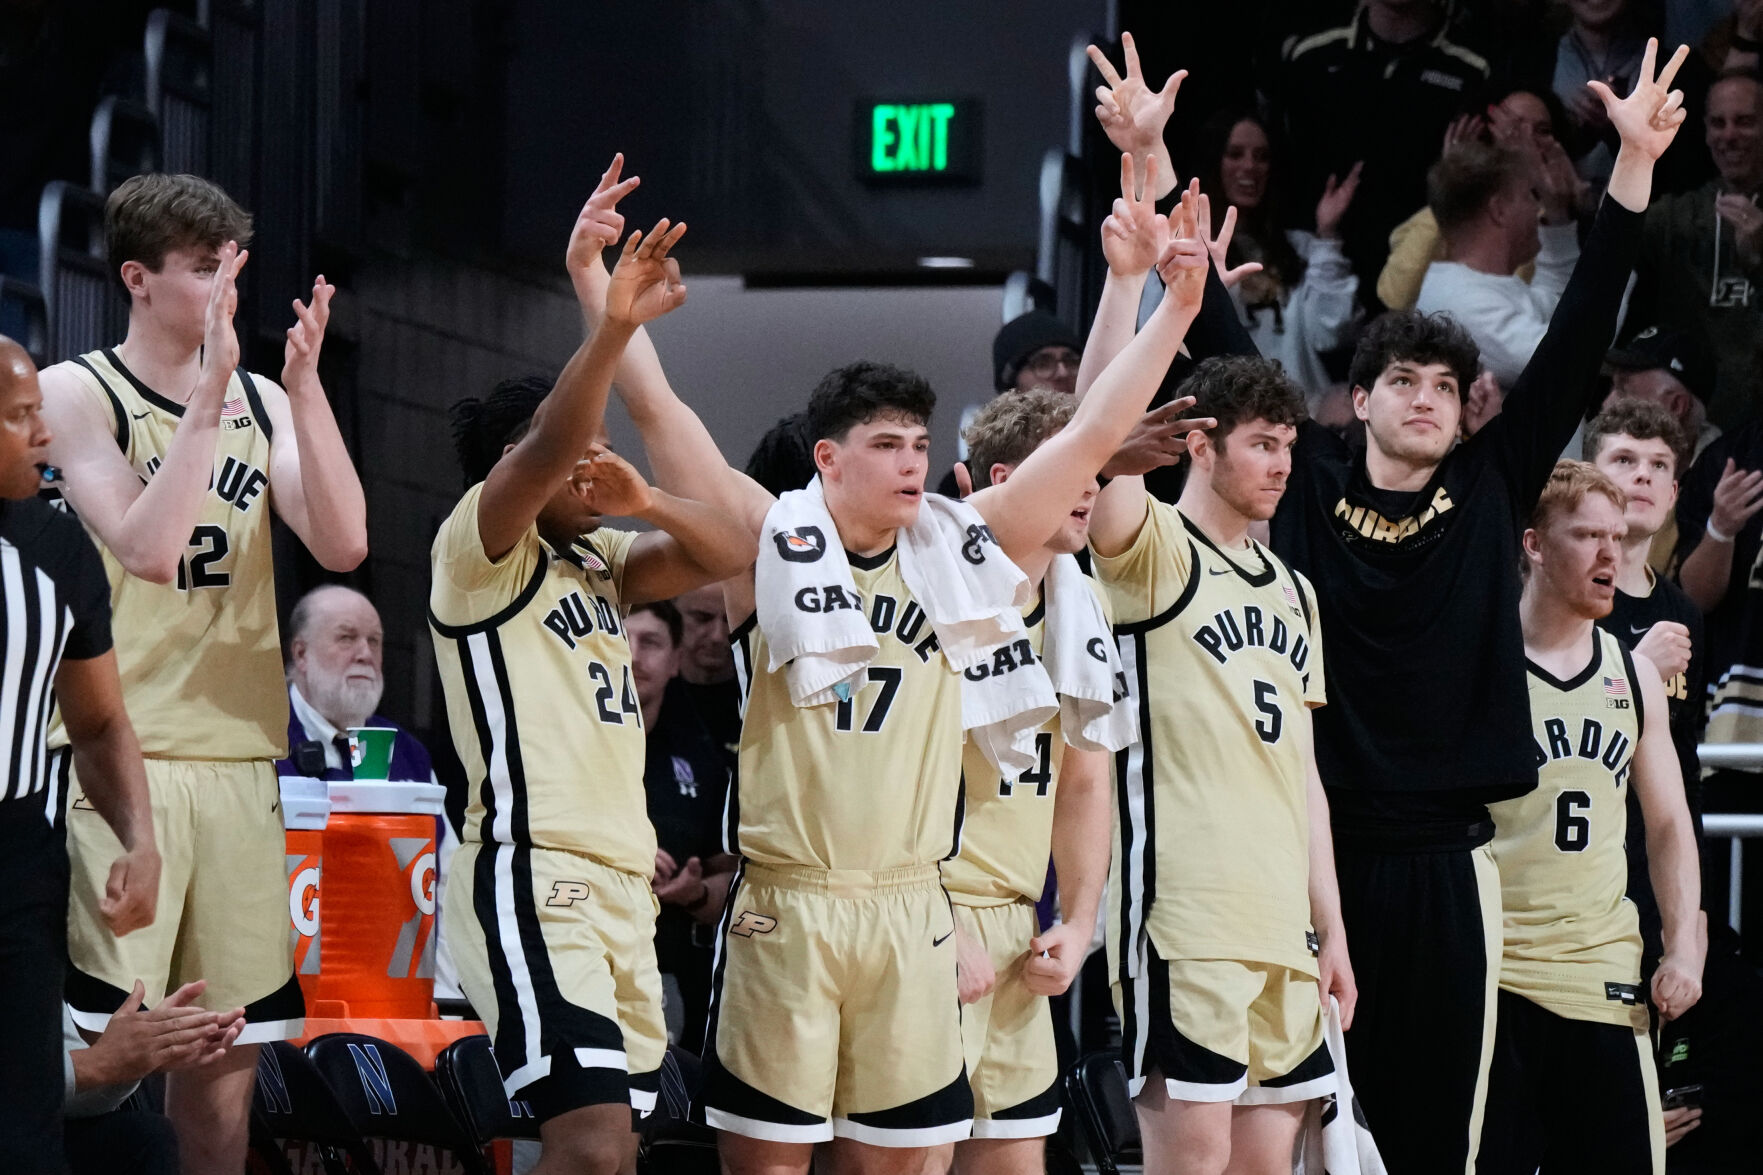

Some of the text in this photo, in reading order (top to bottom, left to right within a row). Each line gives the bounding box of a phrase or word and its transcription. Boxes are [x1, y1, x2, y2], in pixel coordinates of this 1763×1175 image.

[872, 103, 955, 171] EXIT
[587, 661, 642, 729] 24
[1252, 678, 1284, 745] 5
[1554, 790, 1592, 852] 6
[546, 880, 590, 907] P
[730, 910, 778, 938] P
[347, 1043, 398, 1115] N
